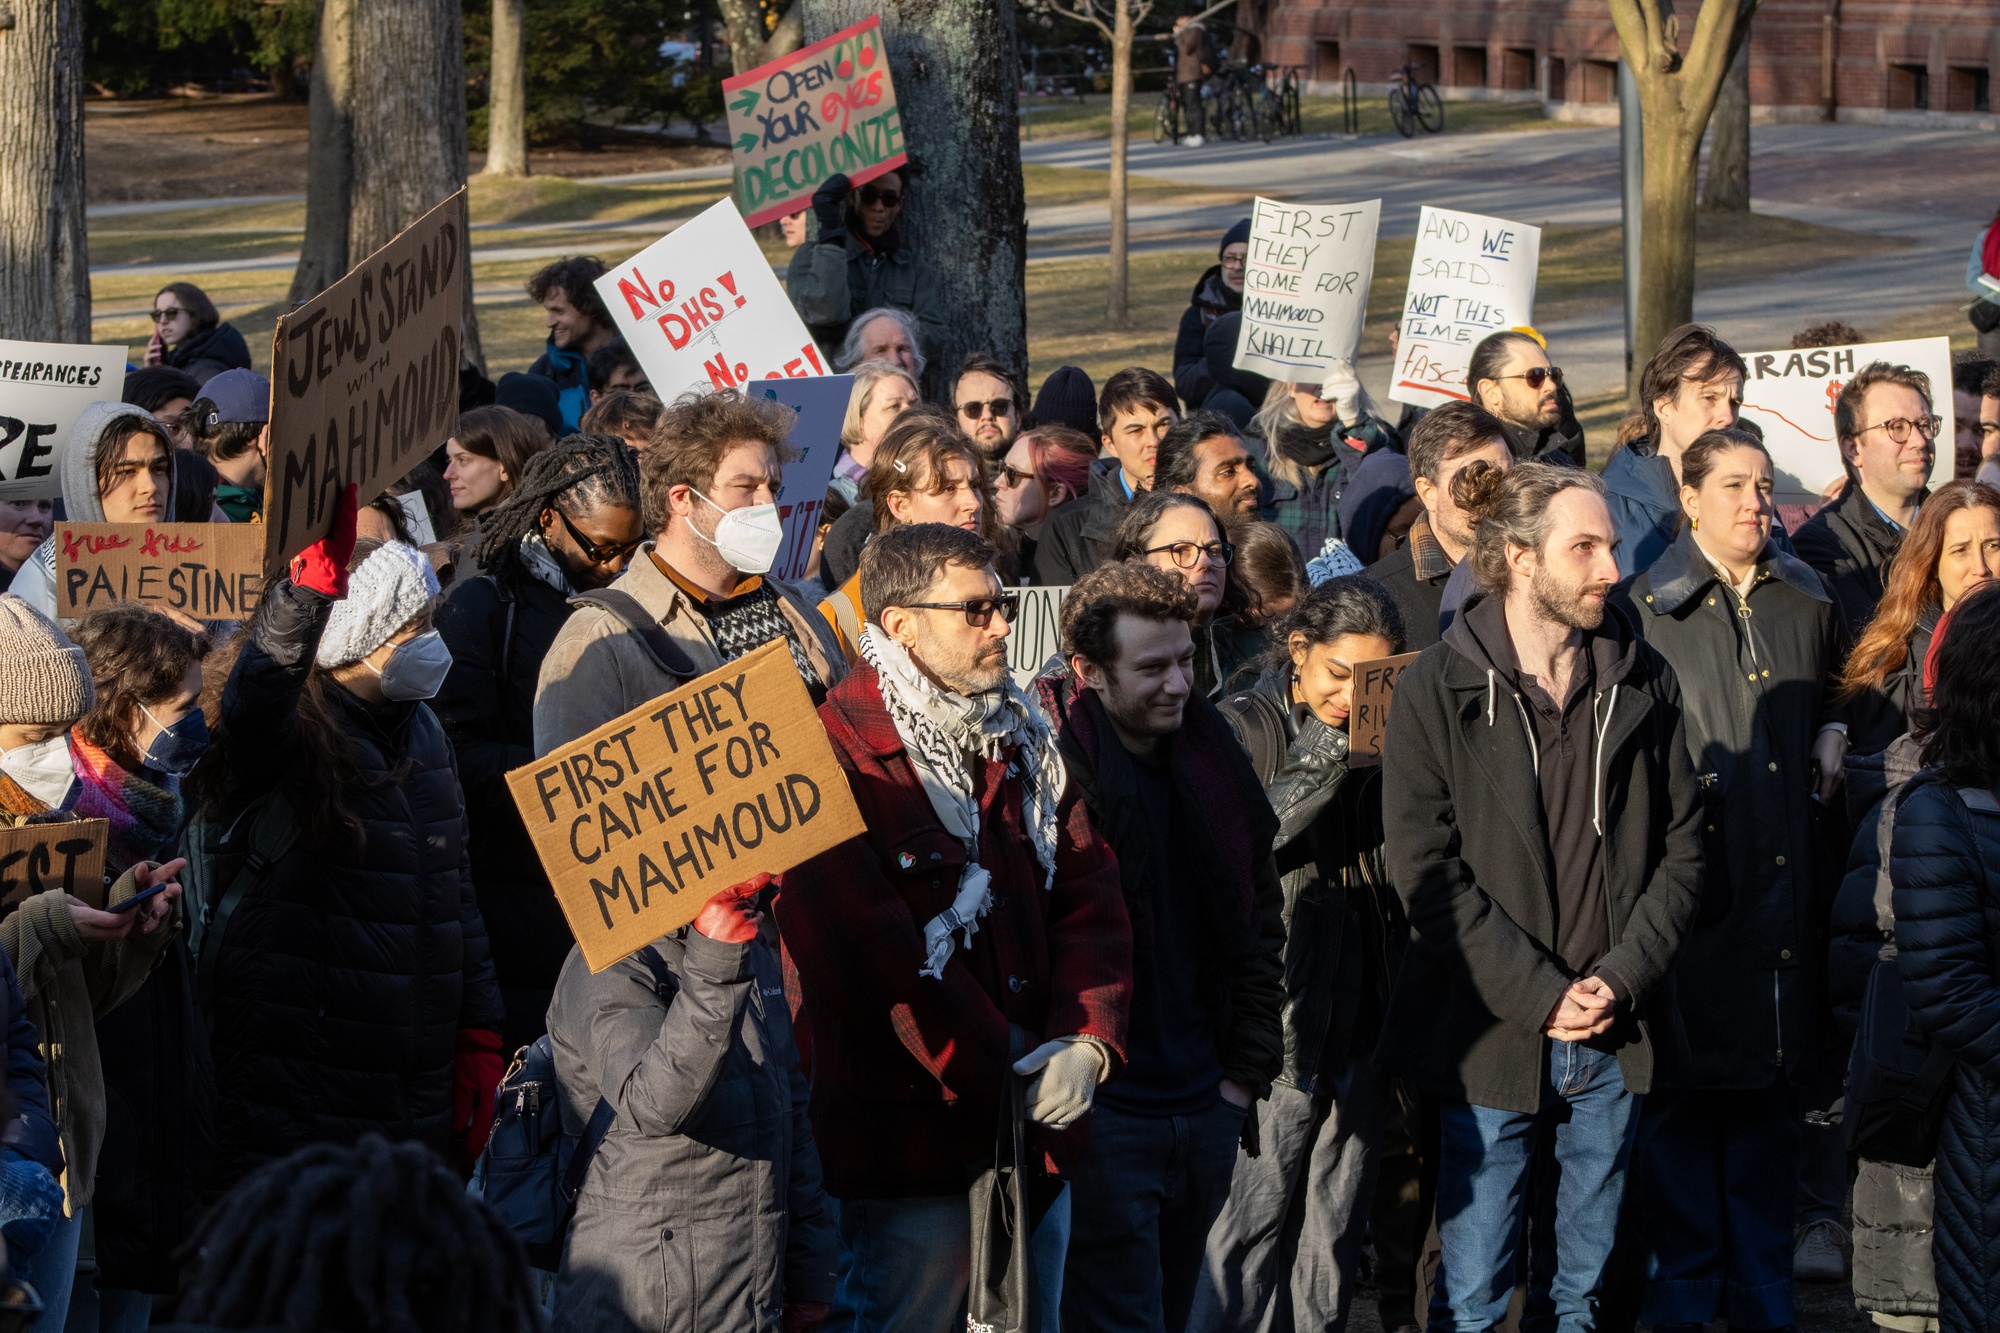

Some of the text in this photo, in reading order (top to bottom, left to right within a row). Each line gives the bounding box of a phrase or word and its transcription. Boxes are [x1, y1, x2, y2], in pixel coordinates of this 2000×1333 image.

[766, 60, 834, 104] OPEN
[757, 70, 883, 150] YOUR eyes
[736, 105, 905, 219] DECOLONIZE
[1256, 201, 1363, 242] FIRST
[1423, 212, 1515, 254] AND WE
[1252, 237, 1320, 271] THEY
[1417, 258, 1504, 287] SAID...
[617, 266, 676, 321] No
[1246, 269, 1359, 294] CAME FOR
[288, 222, 458, 399] JEWS STAND
[657, 270, 747, 351] DHS!
[1244, 296, 1324, 323] MAHMOUD
[1452, 298, 1505, 325] THIS
[0, 360, 102, 386] PEARANCES
[347, 350, 390, 397] WITH
[1743, 348, 1855, 381] RASH
[278, 325, 457, 557] MAHMOUD
[62, 528, 204, 563] free free
[1003, 588, 1063, 672] ION
[1365, 665, 1407, 696] FR
[534, 673, 749, 823] FIRST THEY
[569, 721, 781, 865] CAME FOR
[588, 773, 821, 930] MAHMOUD
